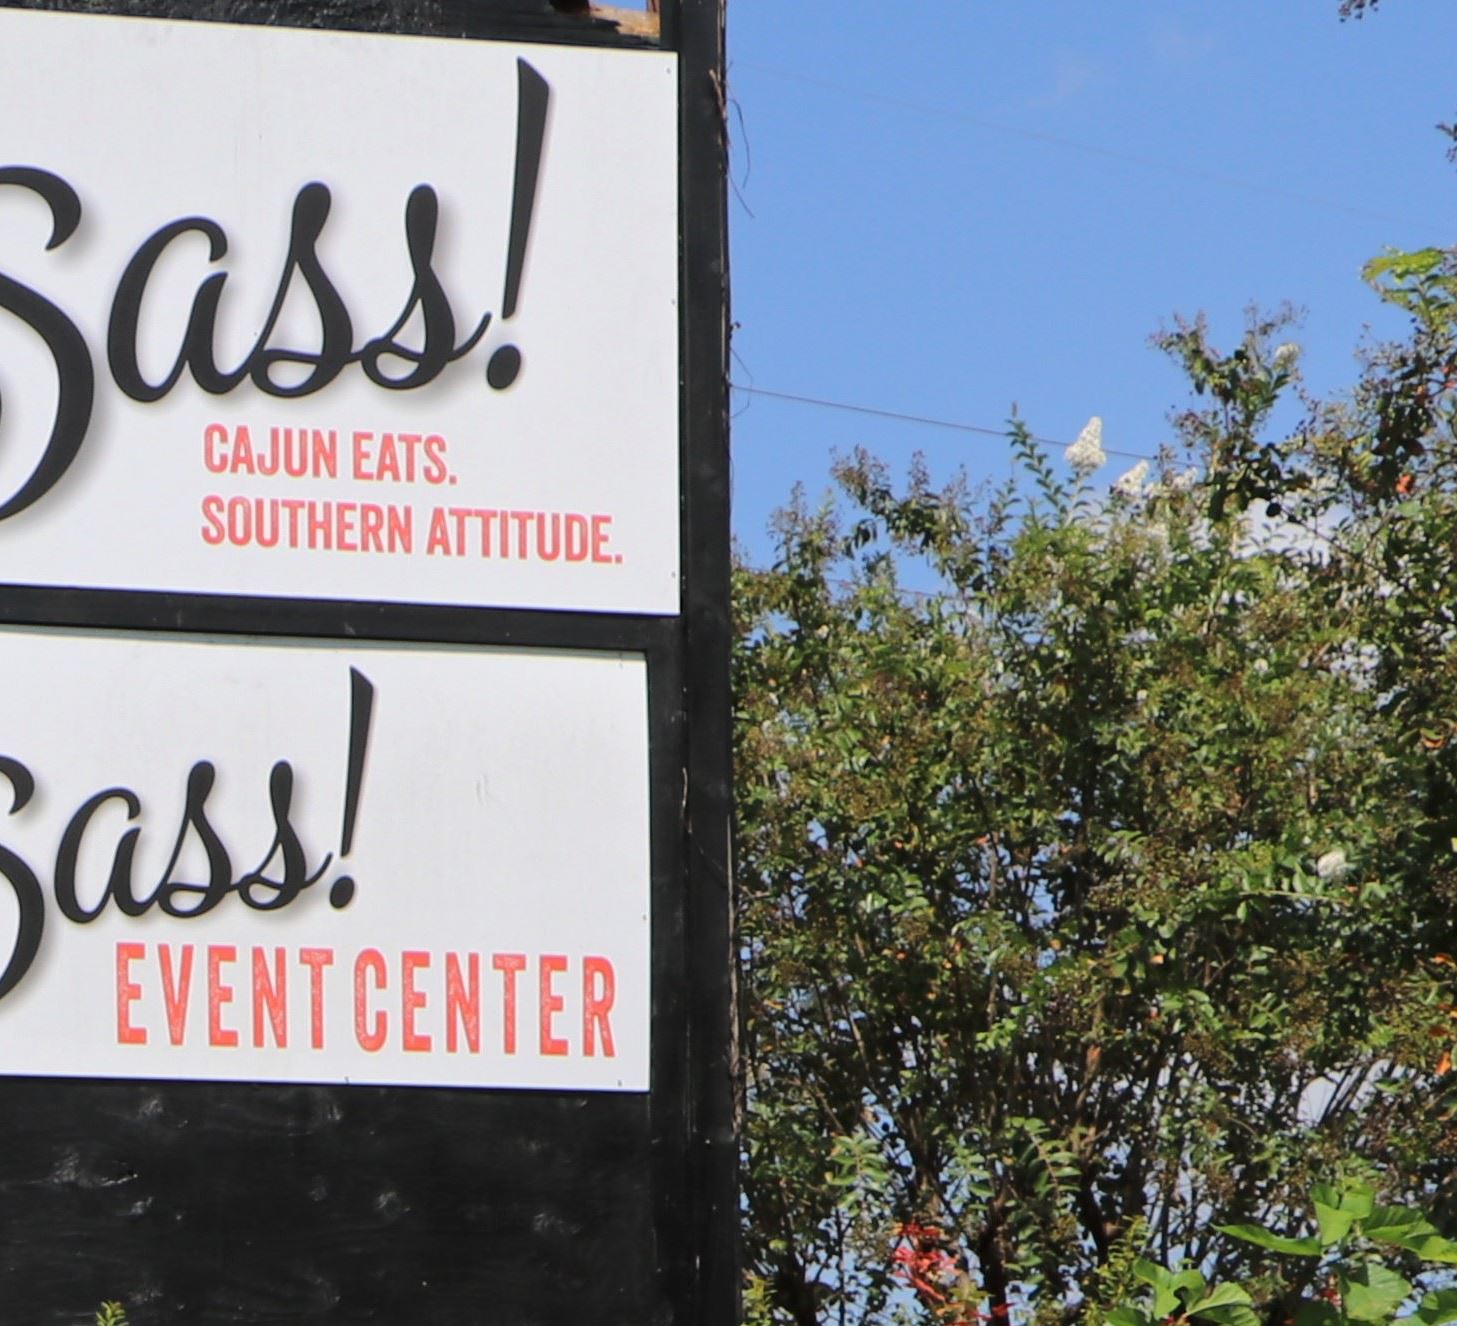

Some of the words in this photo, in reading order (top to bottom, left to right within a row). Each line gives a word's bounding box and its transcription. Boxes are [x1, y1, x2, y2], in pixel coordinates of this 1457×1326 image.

[204, 422, 338, 479] CAJUN
[352, 430, 458, 486] EATS.
[201, 494, 413, 554] SOUTHERN
[426, 506, 624, 565] ATTITUDE.
[115, 941, 336, 1051] EVENT
[353, 947, 617, 1059] CENTER
